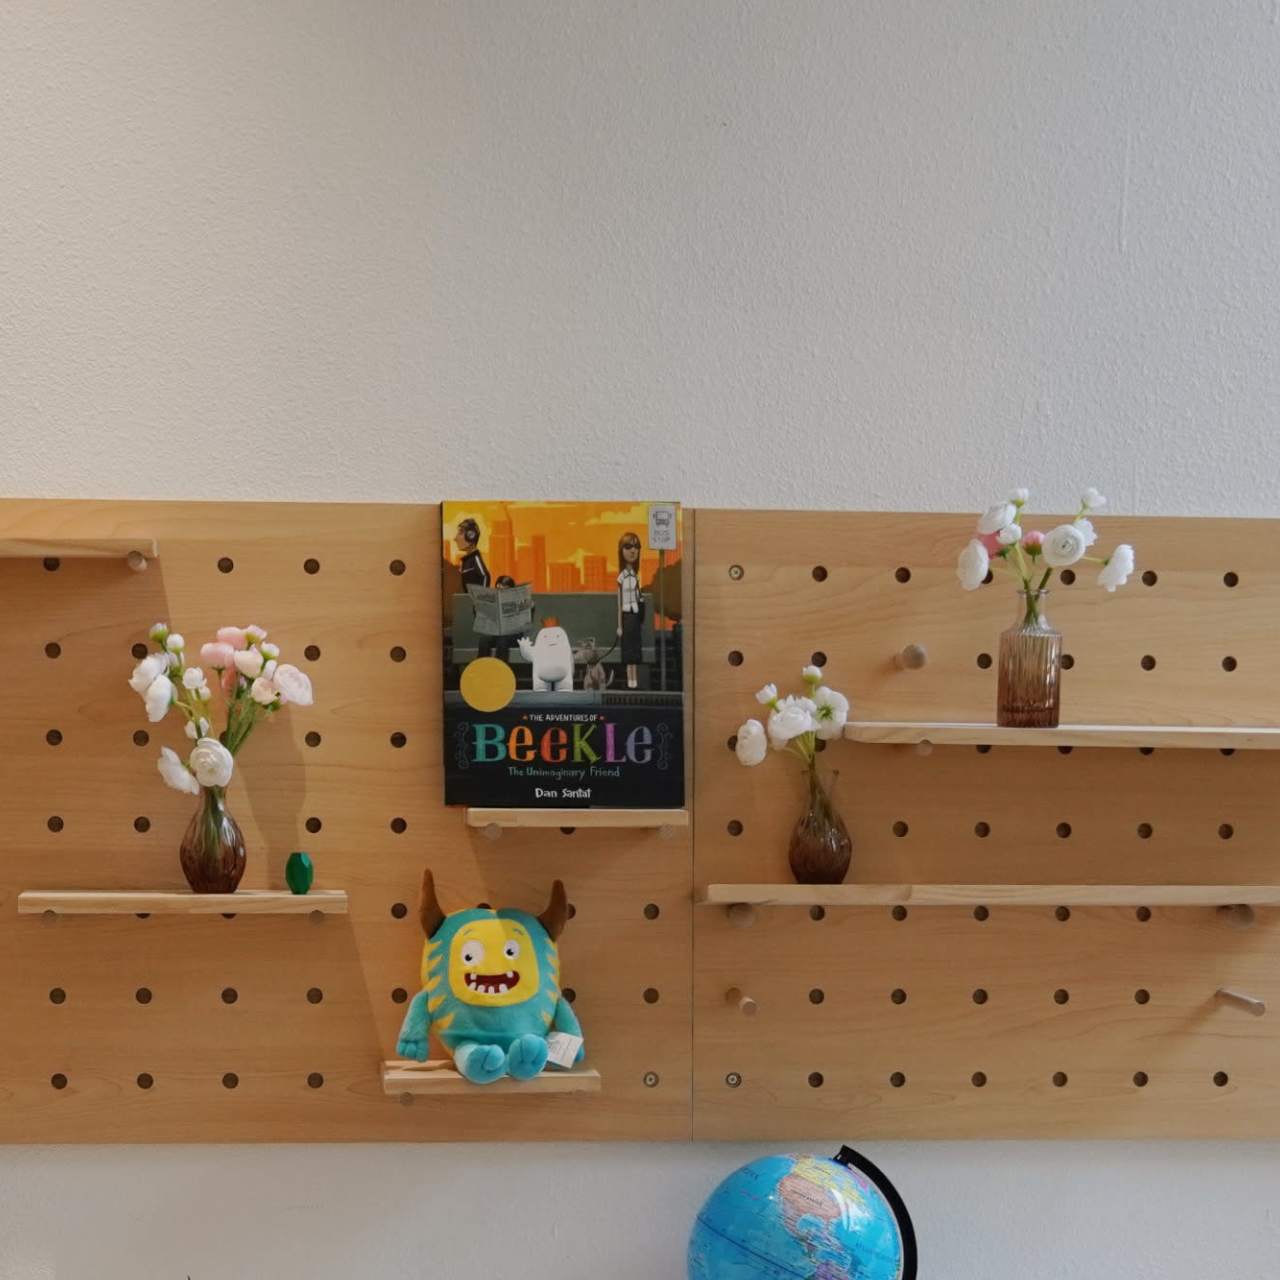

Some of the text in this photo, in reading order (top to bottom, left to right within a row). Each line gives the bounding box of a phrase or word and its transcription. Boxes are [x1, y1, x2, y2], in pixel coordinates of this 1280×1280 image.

[529, 713, 598, 721] THE ADVENTURES OF
[508, 766, 620, 780] The Unimaginary Friend
[534, 787, 592, 798] Dan Santat
